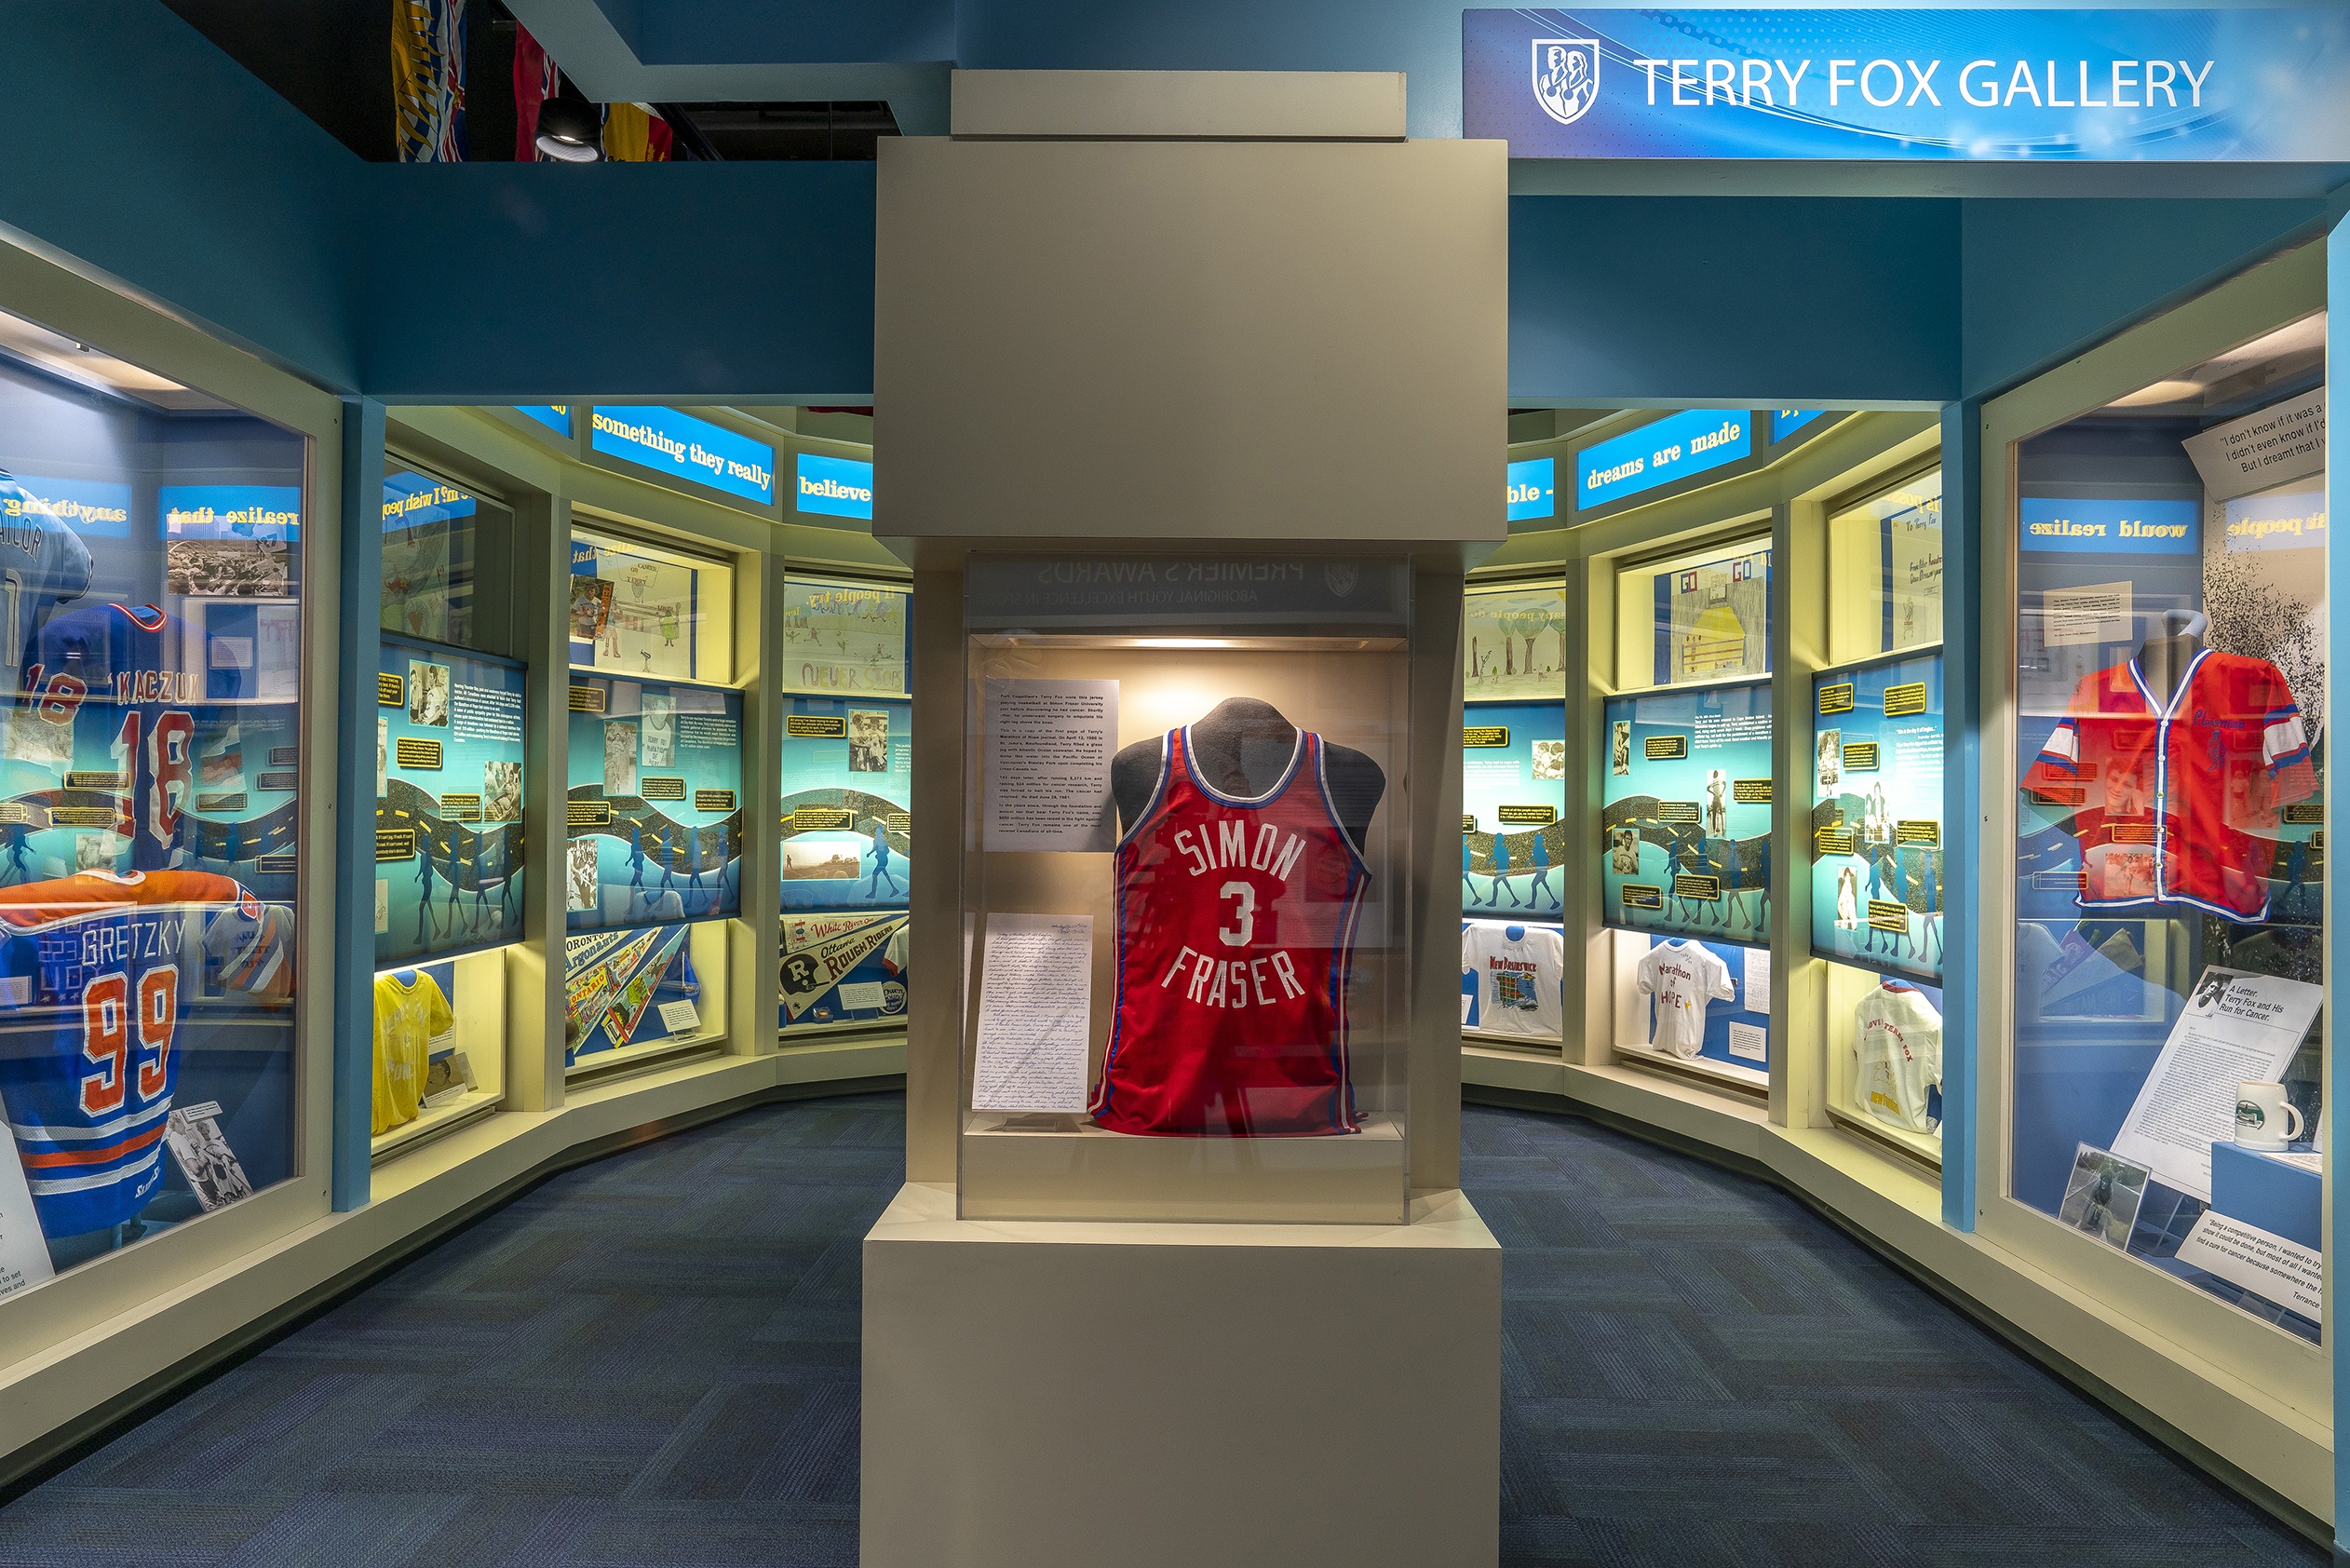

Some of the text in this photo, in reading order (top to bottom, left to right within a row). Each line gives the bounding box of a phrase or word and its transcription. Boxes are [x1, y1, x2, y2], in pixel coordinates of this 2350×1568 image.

[1634, 59, 2214, 108] TERRY FOX GALLERY
[2226, 453, 2230, 461] I
[2232, 445, 2256, 460] didn't
[2258, 438, 2278, 451] even
[2279, 428, 2304, 443] know
[2305, 423, 2313, 434] if
[2230, 429, 2251, 444] don't
[2251, 422, 2276, 436] know
[2277, 416, 2284, 426] if
[2286, 413, 2293, 424] it
[2294, 407, 2314, 420] was
[592, 413, 771, 490] something they really
[1587, 422, 1740, 489] dreams are made
[2241, 438, 2319, 472] But I dreamt that I
[799, 477, 871, 501] believe
[1507, 486, 1539, 504] ble
[1681, 560, 1751, 594] GO GO
[1174, 820, 1306, 881] SIMON
[811, 923, 841, 939] White
[843, 920, 863, 932] River
[1219, 882, 1255, 946] 3
[82, 919, 186, 966] GRETZKY
[566, 933, 603, 952] ORONTO
[821, 938, 855, 958] Ottawa
[823, 926, 893, 980] ROUGH RIDERS
[788, 960, 809, 981] R
[1162, 945, 1305, 1008] FRASER
[1490, 956, 1503, 969] NEW
[1659, 963, 1691, 980] Marathon
[572, 974, 604, 1002] ONTARIO
[1661, 991, 1681, 1008] HOPE
[1670, 977, 1676, 988] of
[2236, 986, 2258, 997] Letter.
[2220, 1004, 2270, 1021] Run for Cancer.
[2225, 994, 2284, 1013] Terry Fox and His
[79, 964, 179, 1117] 99
[1884, 1022, 1904, 1043] TERRY
[1903, 1045, 1912, 1062] FOX
[2203, 1227, 2215, 1236] show
[2219, 1234, 2234, 1243] could
[2240, 1242, 2255, 1252] done,
[2256, 1248, 2266, 1256] but
[2266, 1251, 2281, 1263] most
[2289, 1262, 2297, 1270] all
[2227, 1227, 2257, 1242] competitive
[2256, 1237, 2277, 1251] person,
[2282, 1248, 2303, 1262] wanted
[2304, 1256, 2313, 1264] to
[2313, 1260, 2322, 1270] try
[14, 1279, 25, 1289] and
[2228, 1250, 2246, 1261] cancer
[2246, 1256, 2270, 1271] because
[2270, 1267, 2305, 1287] somewhere
[2305, 1282, 2316, 1291] the
[2292, 1291, 2319, 1308] Terrance
